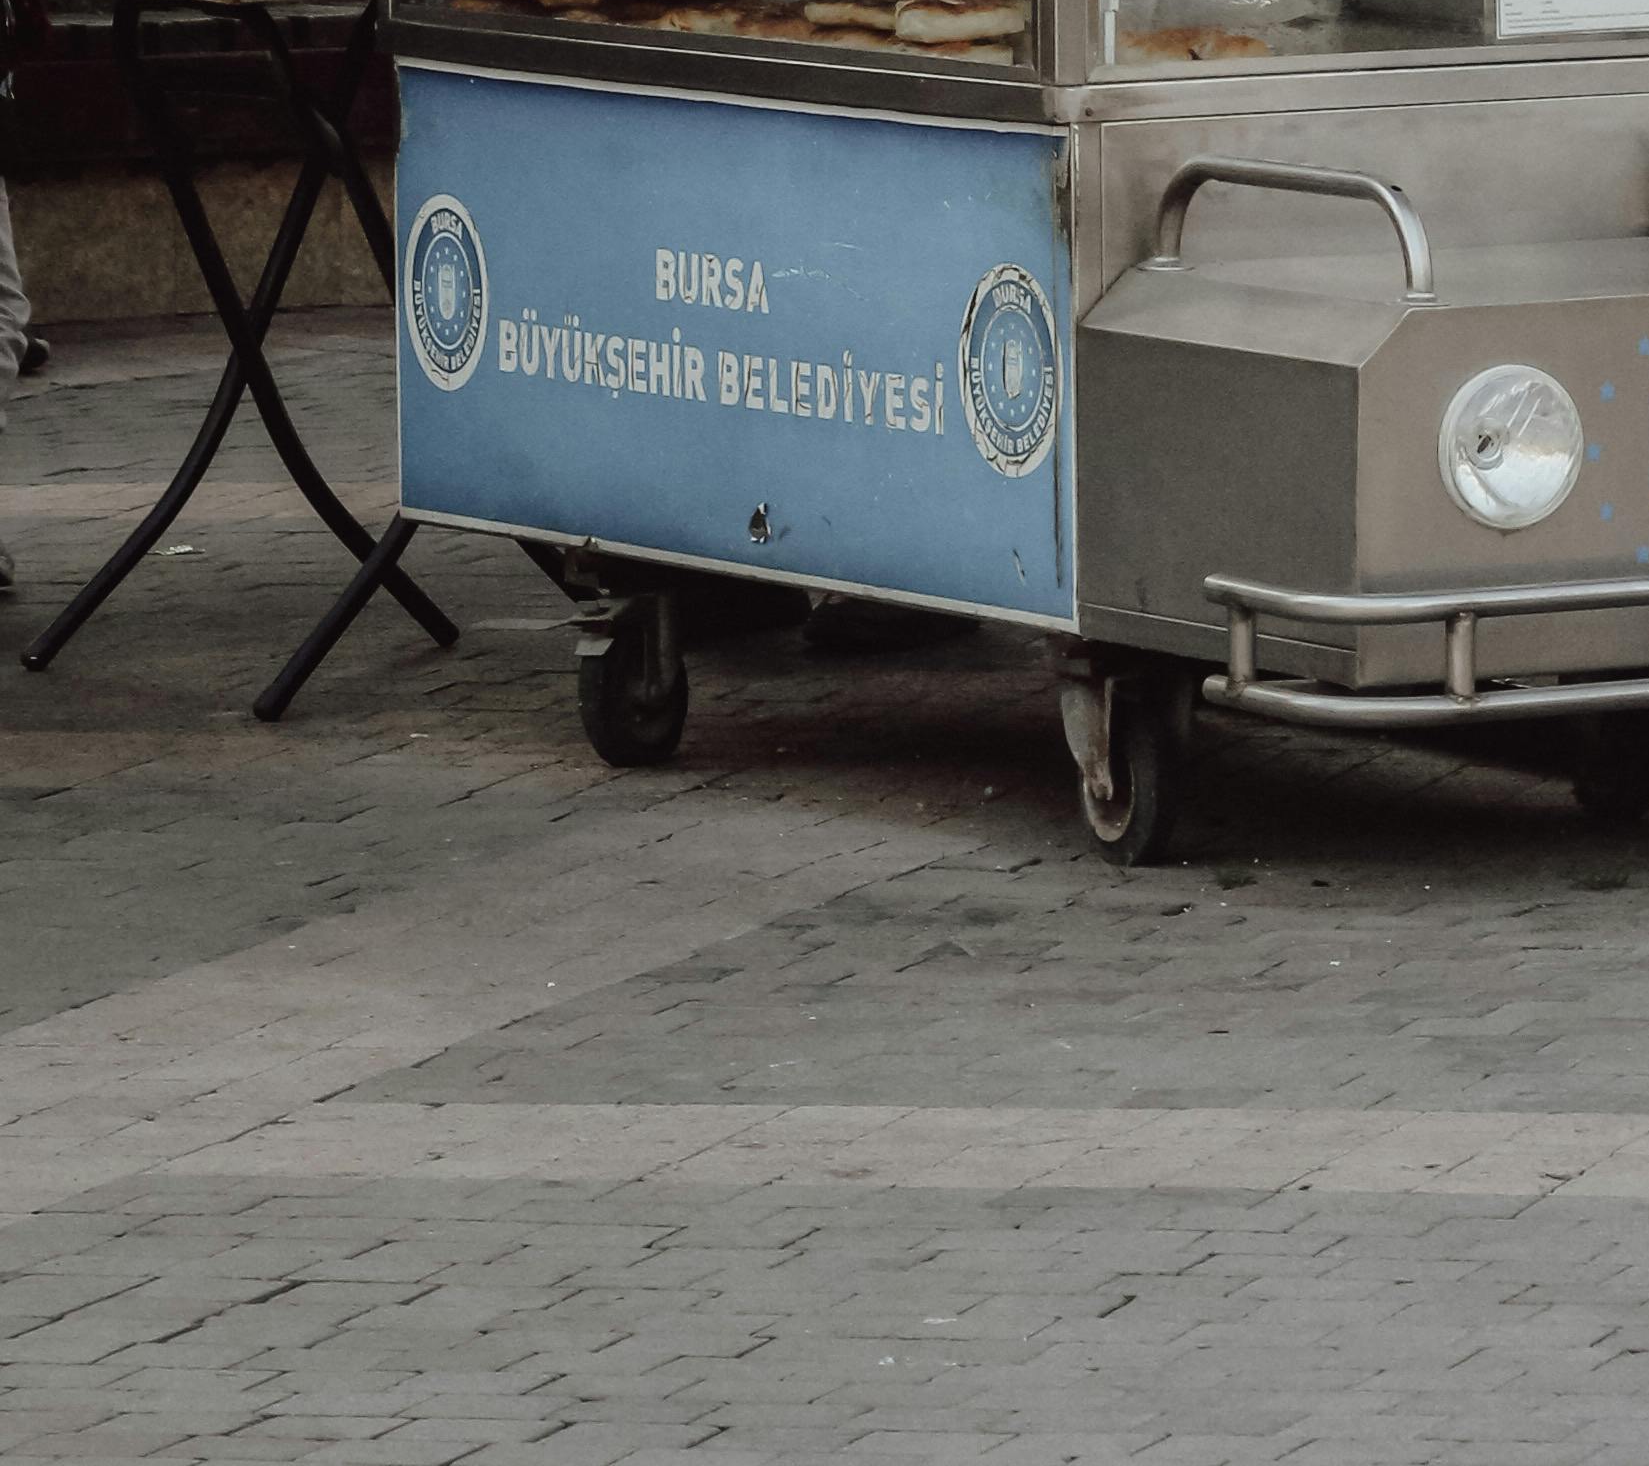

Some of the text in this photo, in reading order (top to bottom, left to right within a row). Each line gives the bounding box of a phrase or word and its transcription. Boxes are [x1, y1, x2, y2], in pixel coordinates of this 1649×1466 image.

[655, 248, 769, 315] BURSA
[499, 307, 944, 435] BÜYÜKŞEHİR BELEDİYESİ
